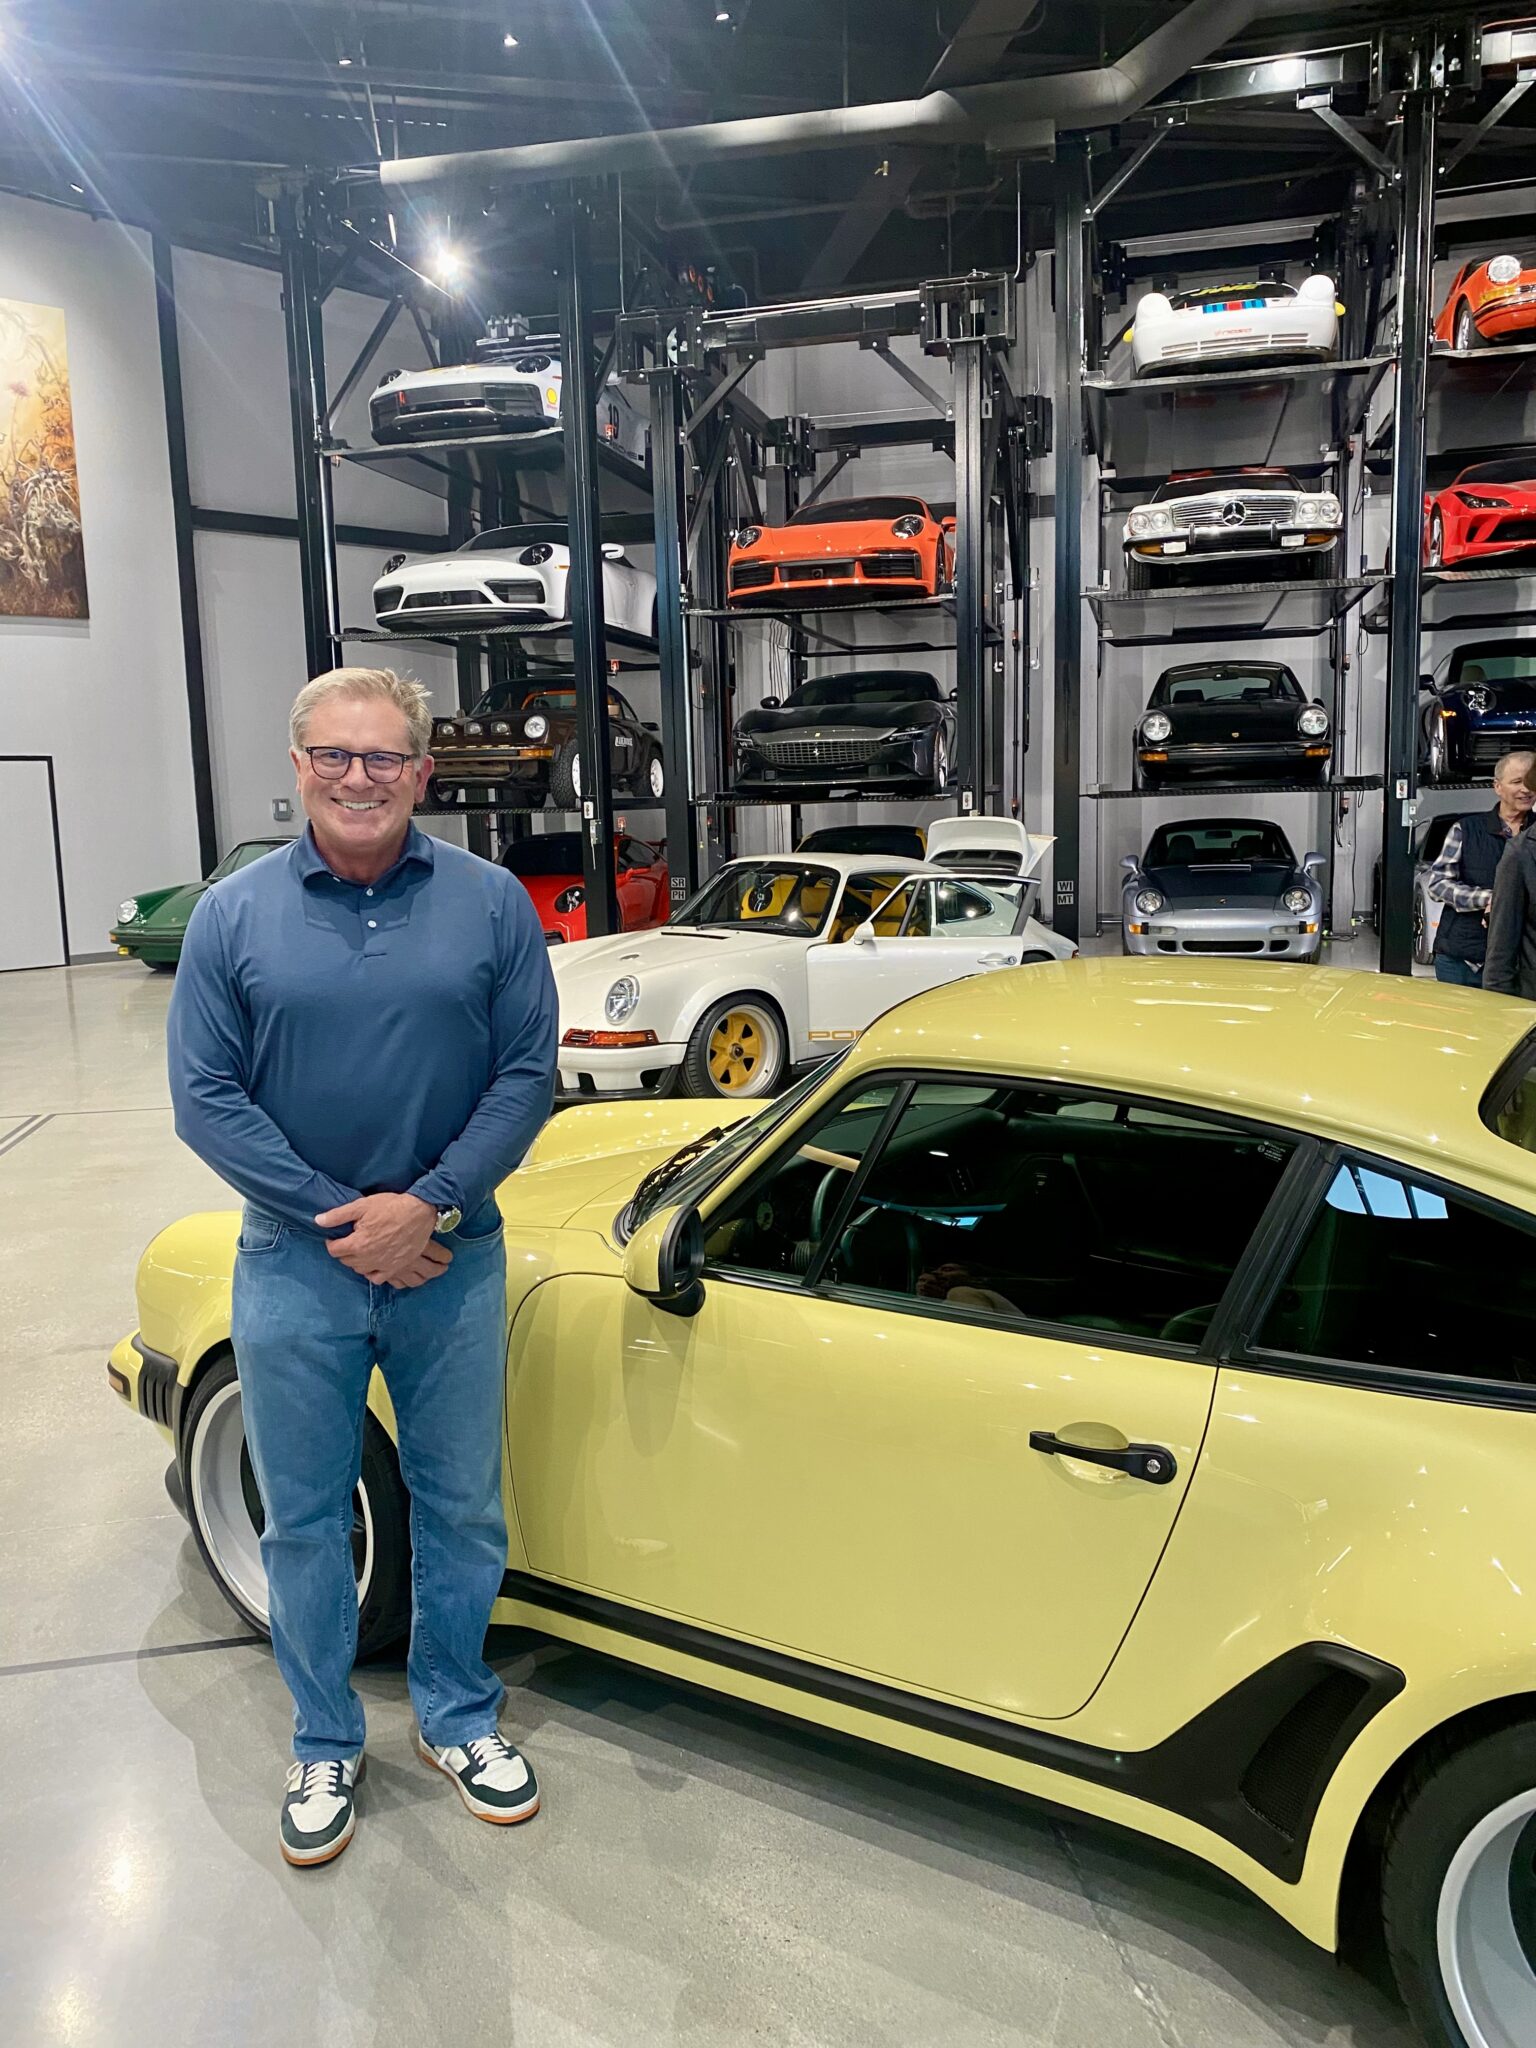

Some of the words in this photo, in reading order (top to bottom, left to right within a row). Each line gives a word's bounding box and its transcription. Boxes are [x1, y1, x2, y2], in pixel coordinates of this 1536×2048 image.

[672, 878, 685, 887] SR
[1058, 881, 1073, 891] WI
[672, 890, 685, 899] PH
[1058, 894, 1073, 904] MT
[808, 1030, 863, 1040] PO
